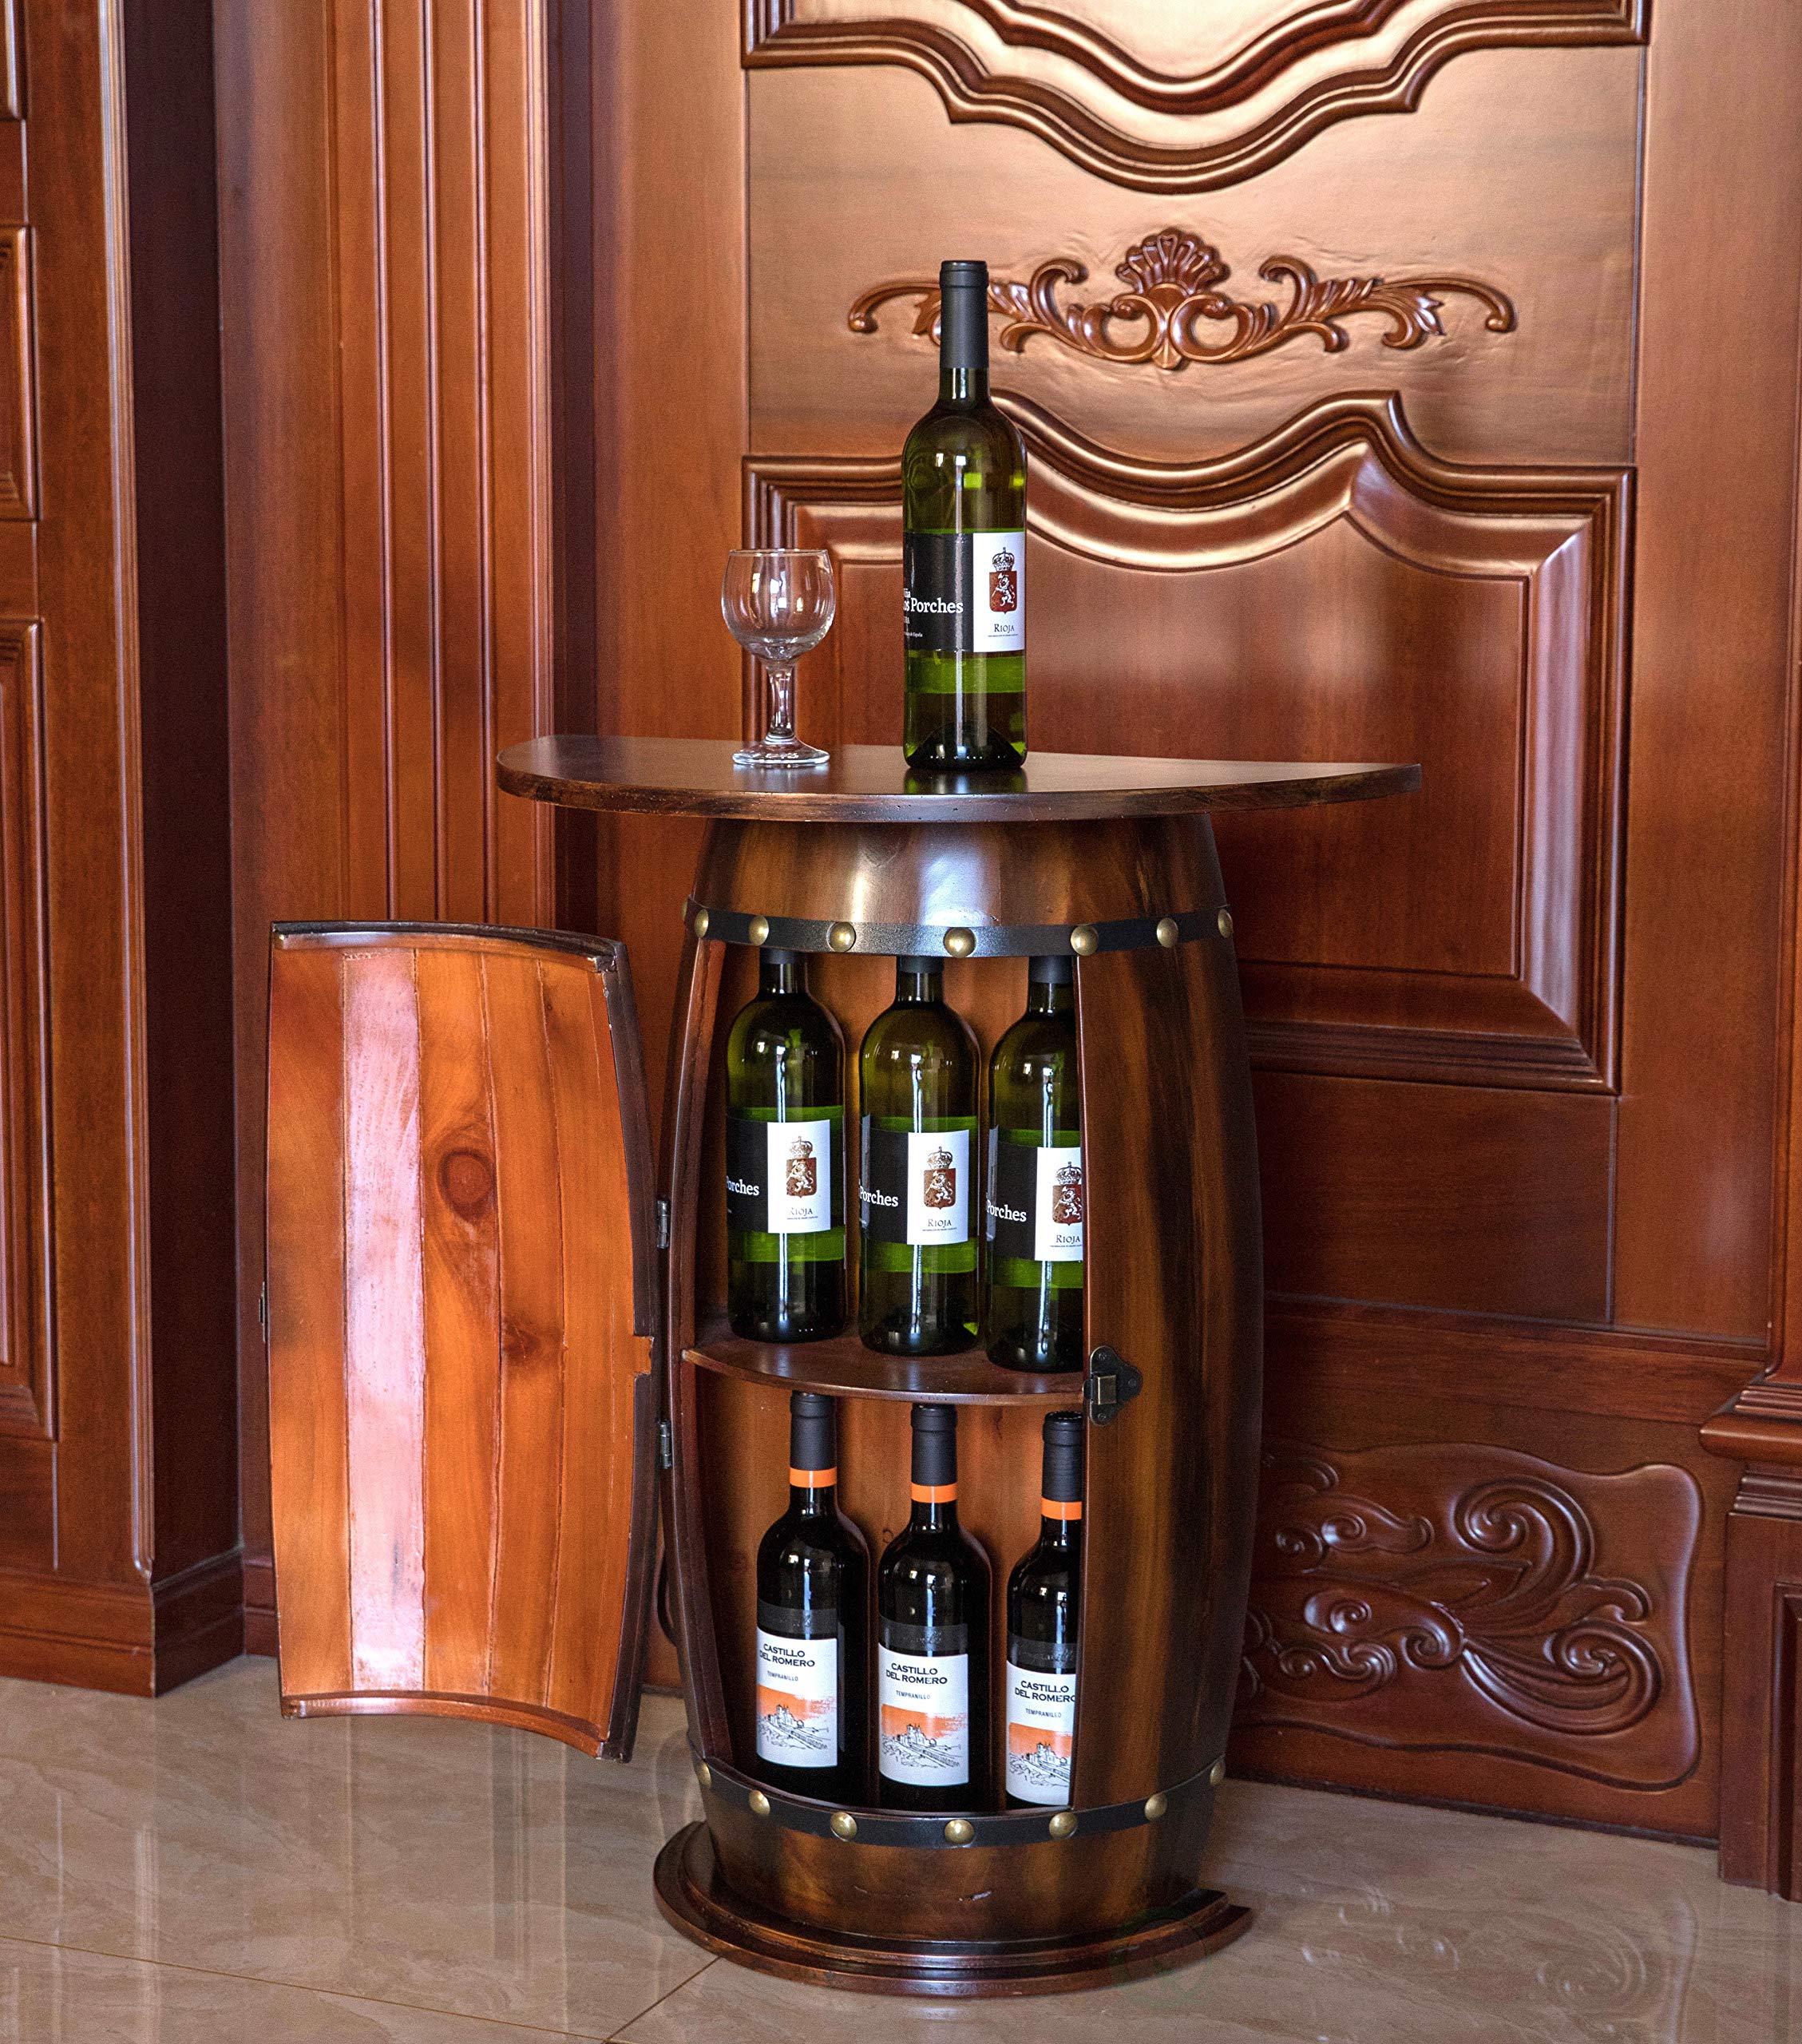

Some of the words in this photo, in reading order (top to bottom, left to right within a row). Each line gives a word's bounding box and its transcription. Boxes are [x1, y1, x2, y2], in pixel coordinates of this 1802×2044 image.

[911, 597, 964, 614] Porches
[994, 624, 1015, 633] RIOJA
[860, 1186, 899, 1207] Porches
[987, 1199, 1027, 1222] Porches
[928, 1218, 952, 1228] RIOJA
[1055, 1234, 1081, 1244] RIOJA
[763, 1643, 806, 1658] CASTILLO
[759, 1650, 771, 1662] DEL
[772, 1655, 815, 1667] ROMERO
[891, 1662, 938, 1675] CASTILLO
[767, 1670, 798, 1682] TEMPRANILLO
[886, 1670, 901, 1681] DEL
[902, 1674, 948, 1684] ROMERO
[1015, 1687, 1031, 1699] DEL
[1020, 1680, 1069, 1693] CASTILLO
[896, 1690, 931, 1700] TEMPRANILLO
[1025, 1709, 1062, 1718] TEMPRANILLO
